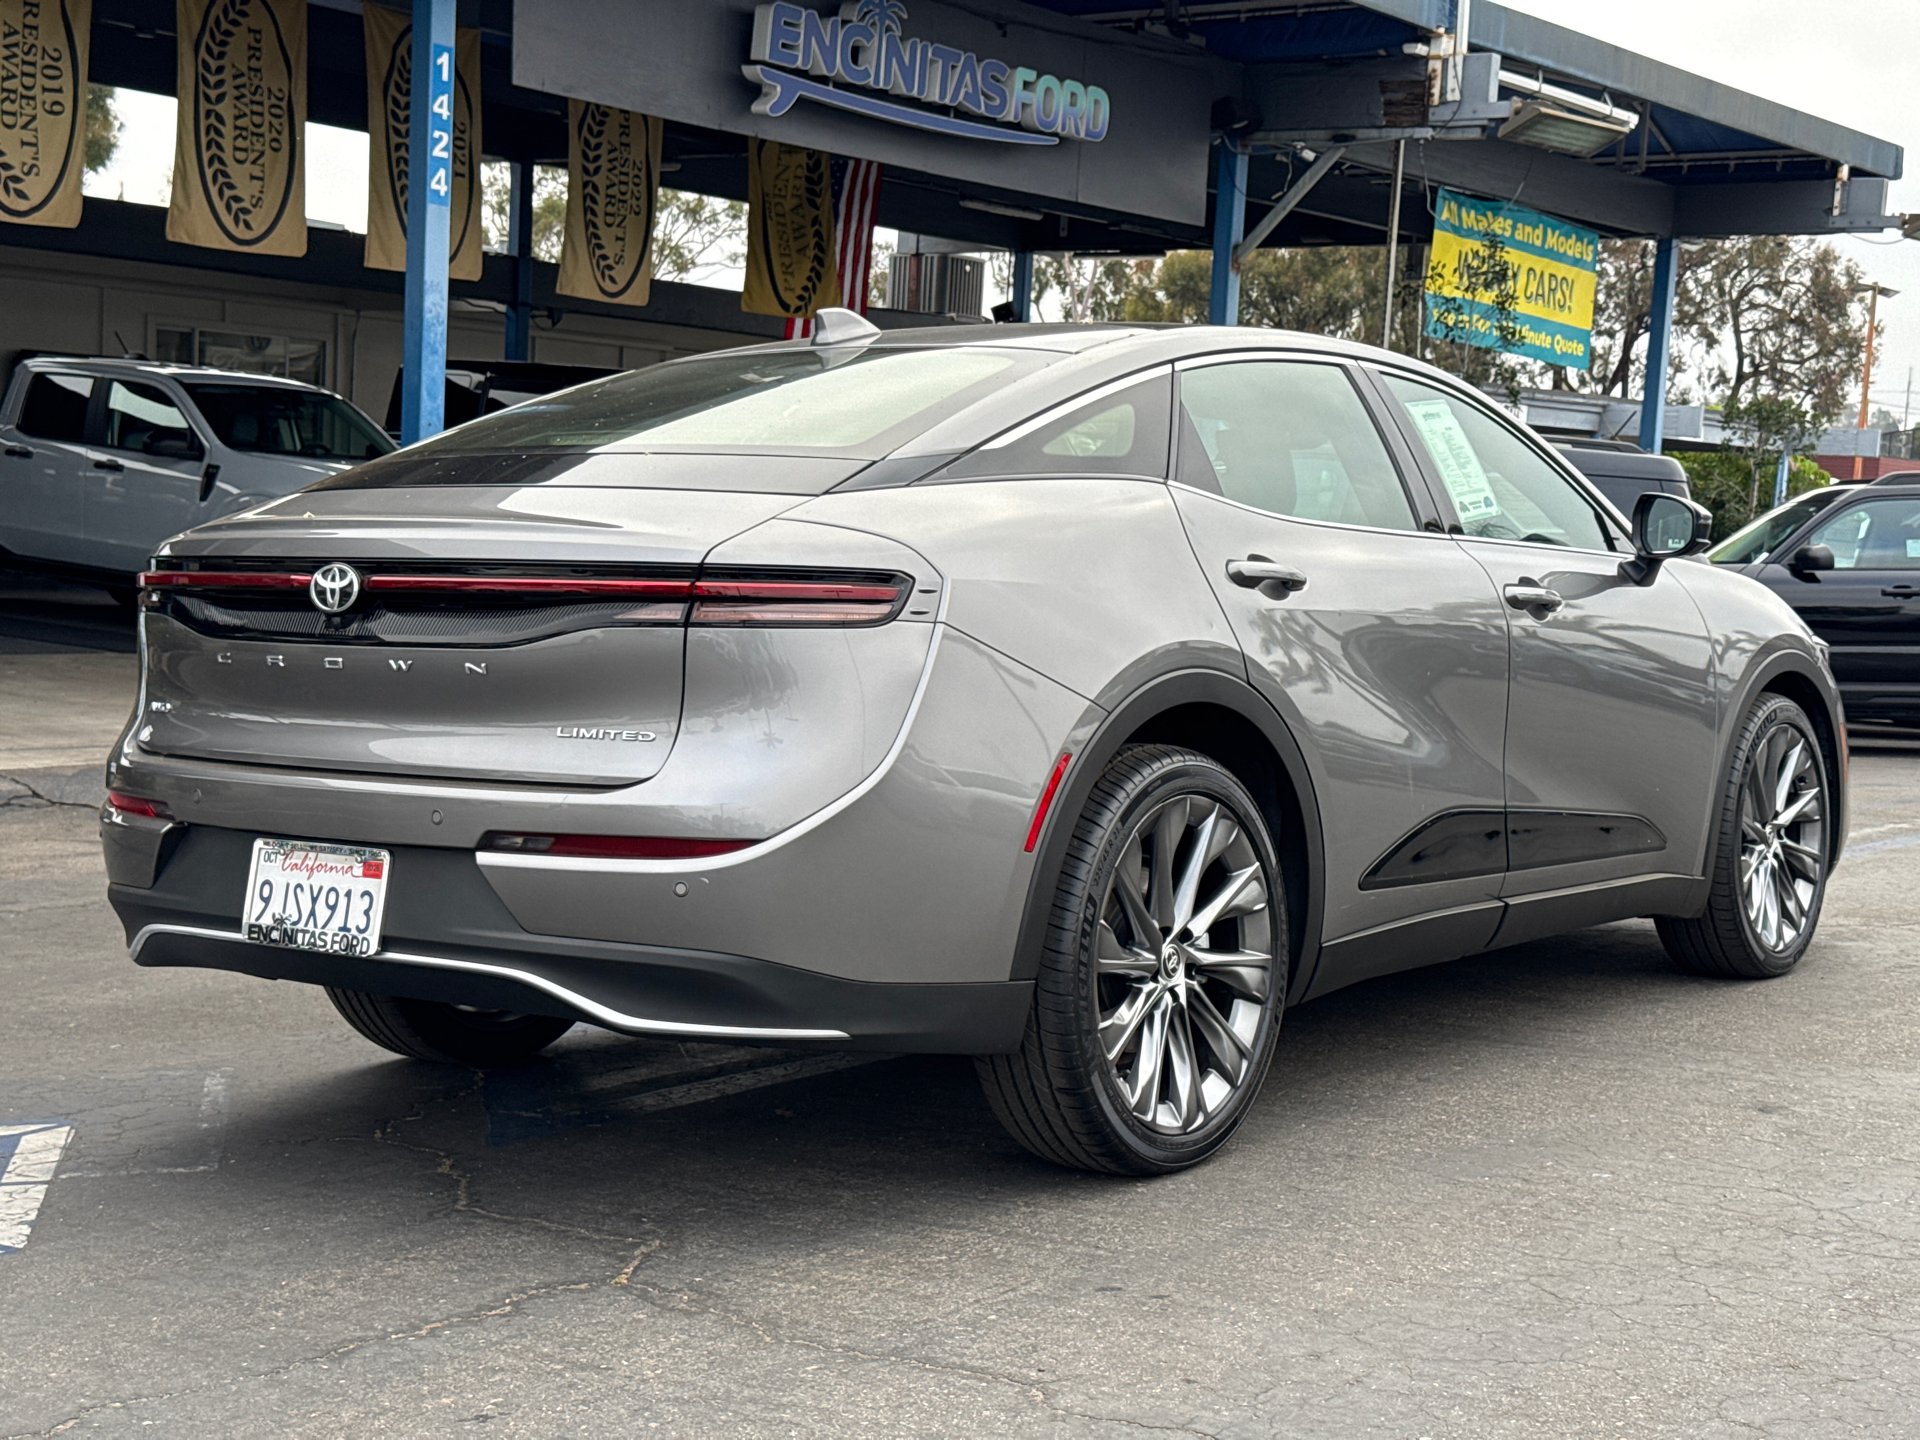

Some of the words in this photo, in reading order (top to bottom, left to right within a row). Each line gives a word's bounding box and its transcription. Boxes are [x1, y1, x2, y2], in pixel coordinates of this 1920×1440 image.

[0, 20, 21, 131] AWARD
[19, 0, 41, 178] RESIDENT'S
[41, 46, 66, 117] 2019
[766, 0, 1010, 119] ENCINITAS
[1013, 66, 1110, 142] FORD
[231, 63, 249, 166] AWARD
[247, 26, 266, 210] PRESIDENT'S
[267, 87, 286, 153] 2020
[454, 121, 467, 179] 2021
[603, 140, 620, 229] AWARD
[612, 109, 632, 267] PRESIDENT'S
[629, 159, 643, 217] 2022
[790, 163, 811, 261] AWARD
[772, 143, 796, 294] PRESIDENT
[1441, 200, 1459, 226] All
[1515, 222, 1543, 246] and
[1545, 228, 1594, 262] Models
[1523, 266, 1575, 314] CARS!
[1554, 334, 1585, 356] Quote
[217, 652, 487, 675] CROWN
[556, 726, 657, 742] LIMITED
[263, 851, 278, 864] OCT
[281, 850, 358, 880] California
[247, 921, 329, 950] ENCINITAS
[330, 932, 371, 956] FORD
